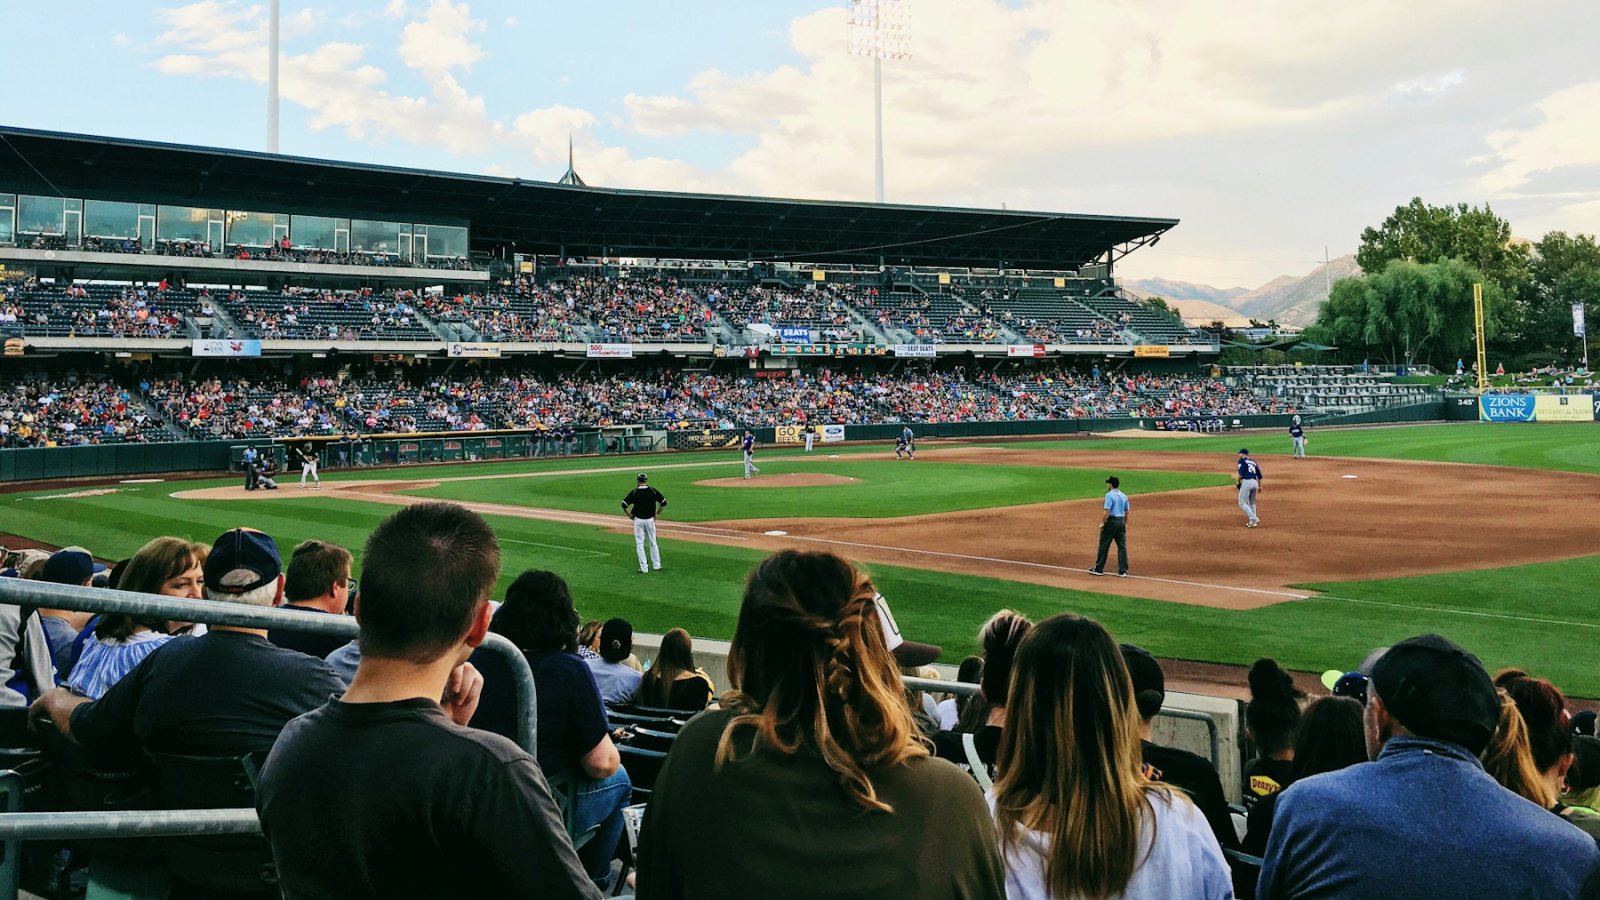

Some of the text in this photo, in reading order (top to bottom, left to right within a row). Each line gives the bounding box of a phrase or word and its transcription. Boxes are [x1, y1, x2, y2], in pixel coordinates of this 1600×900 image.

[784, 328, 808, 336] SEATS
[1489, 397, 1526, 407] ZIONS
[1490, 407, 1527, 418] BANK
[778, 427, 796, 436] GO
